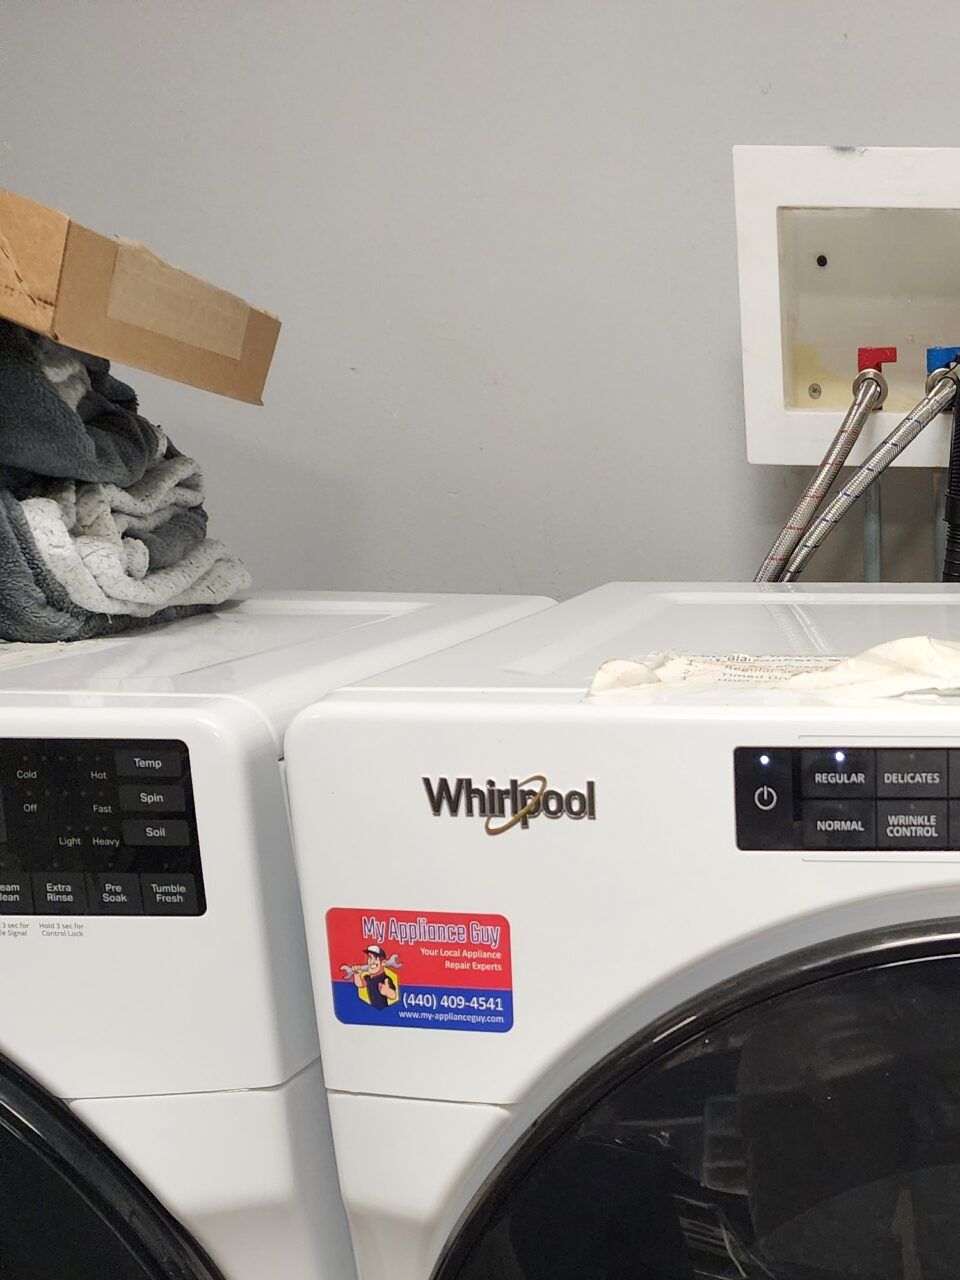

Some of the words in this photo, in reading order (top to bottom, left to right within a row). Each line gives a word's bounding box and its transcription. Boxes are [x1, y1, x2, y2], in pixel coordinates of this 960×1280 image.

[134, 758, 162, 769] Temp
[16, 770, 37, 779] Cold
[91, 771, 107, 779] Hot
[815, 773, 865, 783] REGULAR
[884, 773, 940, 783] DELICATES
[140, 793, 163, 804] Spin
[421, 776, 597, 830] Whirlpool
[23, 803, 38, 812] Off
[93, 804, 112, 813] Fast
[888, 815, 936, 825] WRINKLE
[816, 820, 864, 831] NORMAL
[145, 827, 166, 837] Soil
[886, 826, 938, 837] CONTROL
[59, 837, 81, 847] Light
[92, 837, 120, 847] Heavy
[0, 884, 20, 892] eam
[46, 883, 72, 892] Extra
[105, 884, 121, 892] Pre
[151, 884, 186, 893] Tumble
[47, 893, 73, 902] Rinse
[102, 893, 127, 902] Soak
[156, 893, 183, 902] Fresh
[362, 916, 386, 943] My
[388, 916, 466, 945] Appliance
[470, 921, 501, 949] Guy
[420, 947, 438, 956] Your
[440, 948, 460, 957] Local
[462, 950, 501, 960] Appliance
[445, 960, 471, 971] Repair
[472, 962, 502, 973] Experts
[402, 992, 437, 1010] (440)
[440, 995, 504, 1011] 409-4541
[399, 1010, 504, 1024] www.my-applianceguy.com
